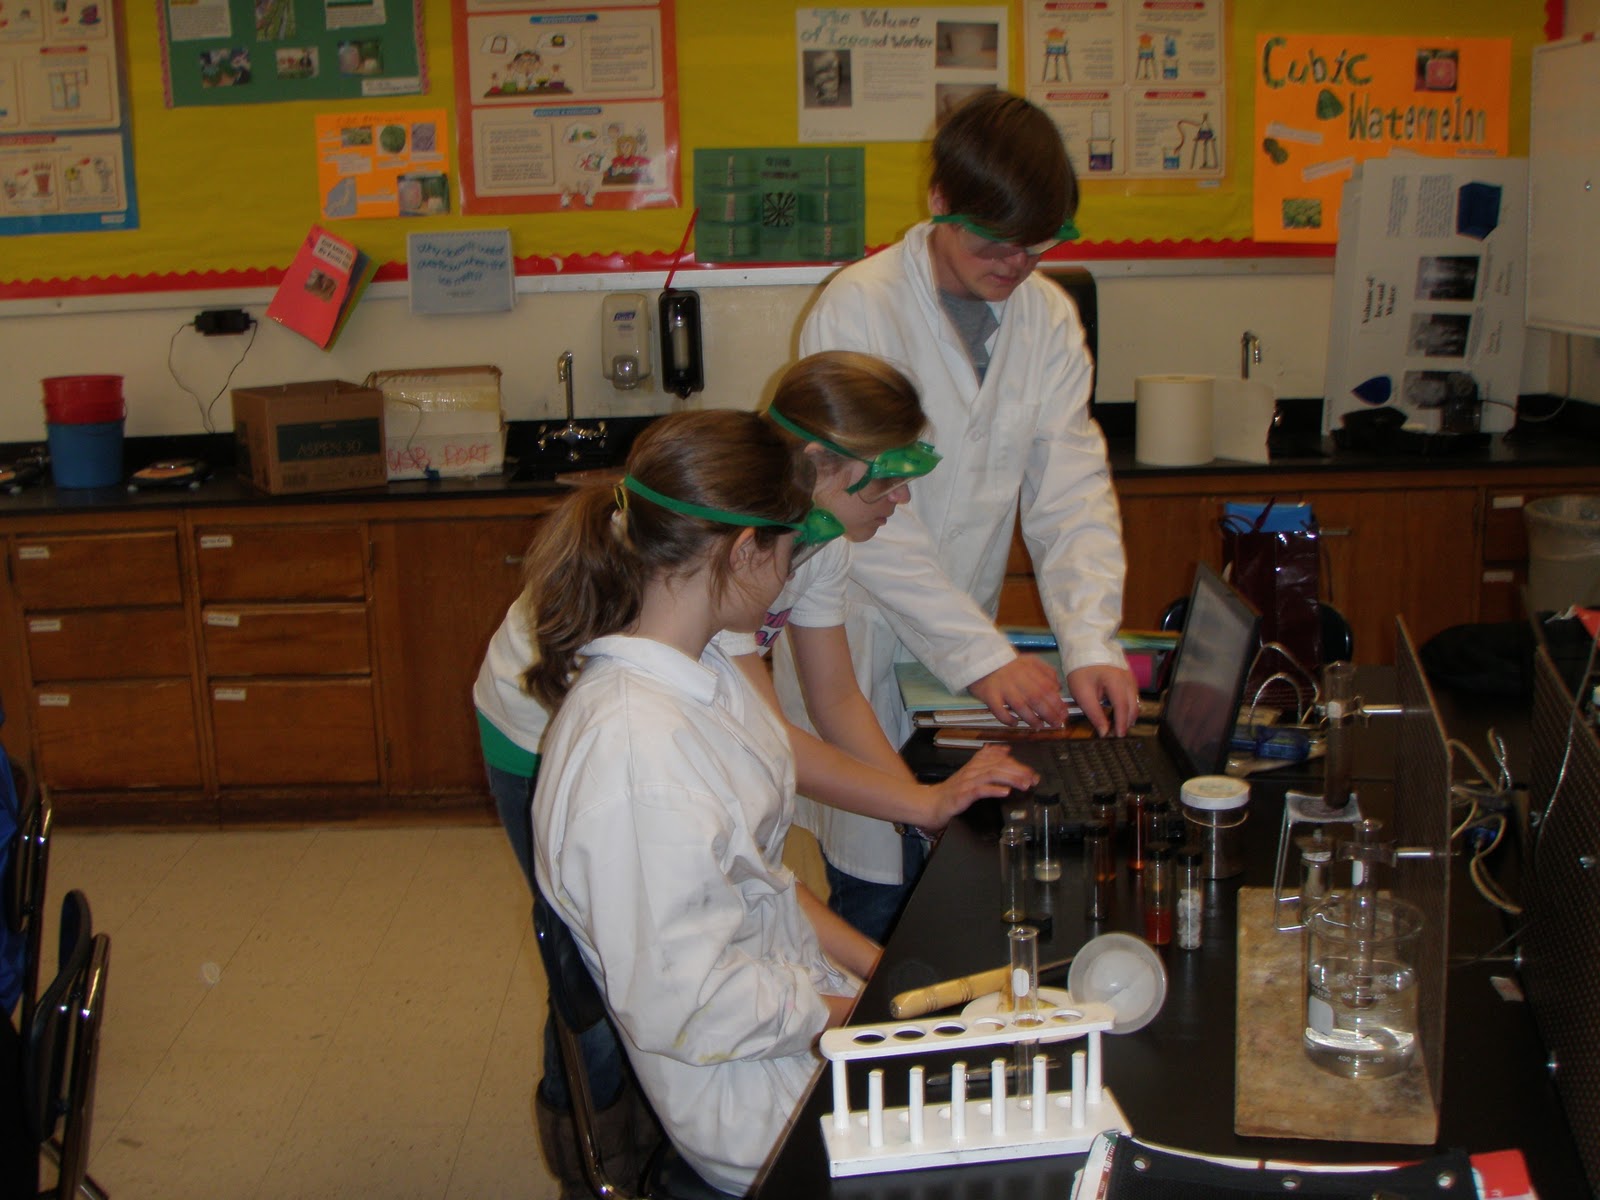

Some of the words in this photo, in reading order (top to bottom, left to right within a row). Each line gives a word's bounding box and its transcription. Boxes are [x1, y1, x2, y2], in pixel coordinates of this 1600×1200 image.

[812, 8, 850, 24] The
[861, 8, 920, 27] Volume
[801, 25, 823, 42] of
[1263, 37, 1373, 88] Cubic
[1349, 93, 1486, 142] Watermelon
[388, 447, 429, 473] USB
[443, 444, 492, 469] PORT
